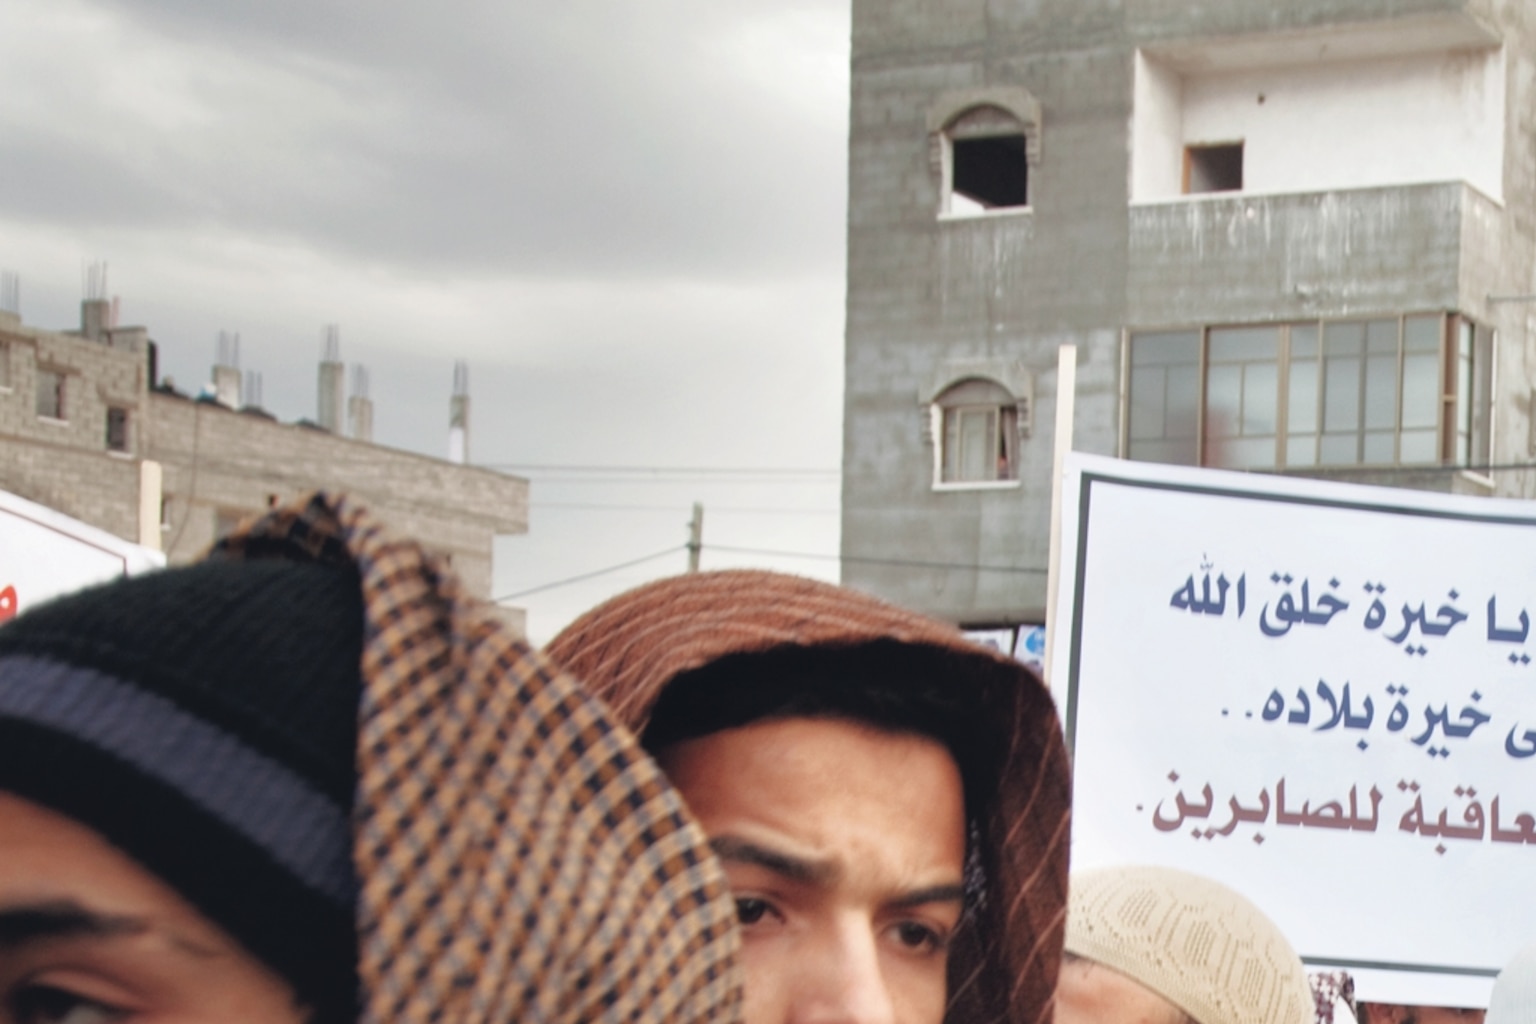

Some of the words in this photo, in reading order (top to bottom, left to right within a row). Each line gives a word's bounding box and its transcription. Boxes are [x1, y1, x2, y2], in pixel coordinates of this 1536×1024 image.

[1169, 552, 1247, 620] الله
[1258, 571, 1350, 639] خلق
[1362, 580, 1468, 658] خيرة
[1487, 593, 1532, 667] يا
[1385, 683, 1492, 760] خيرة
